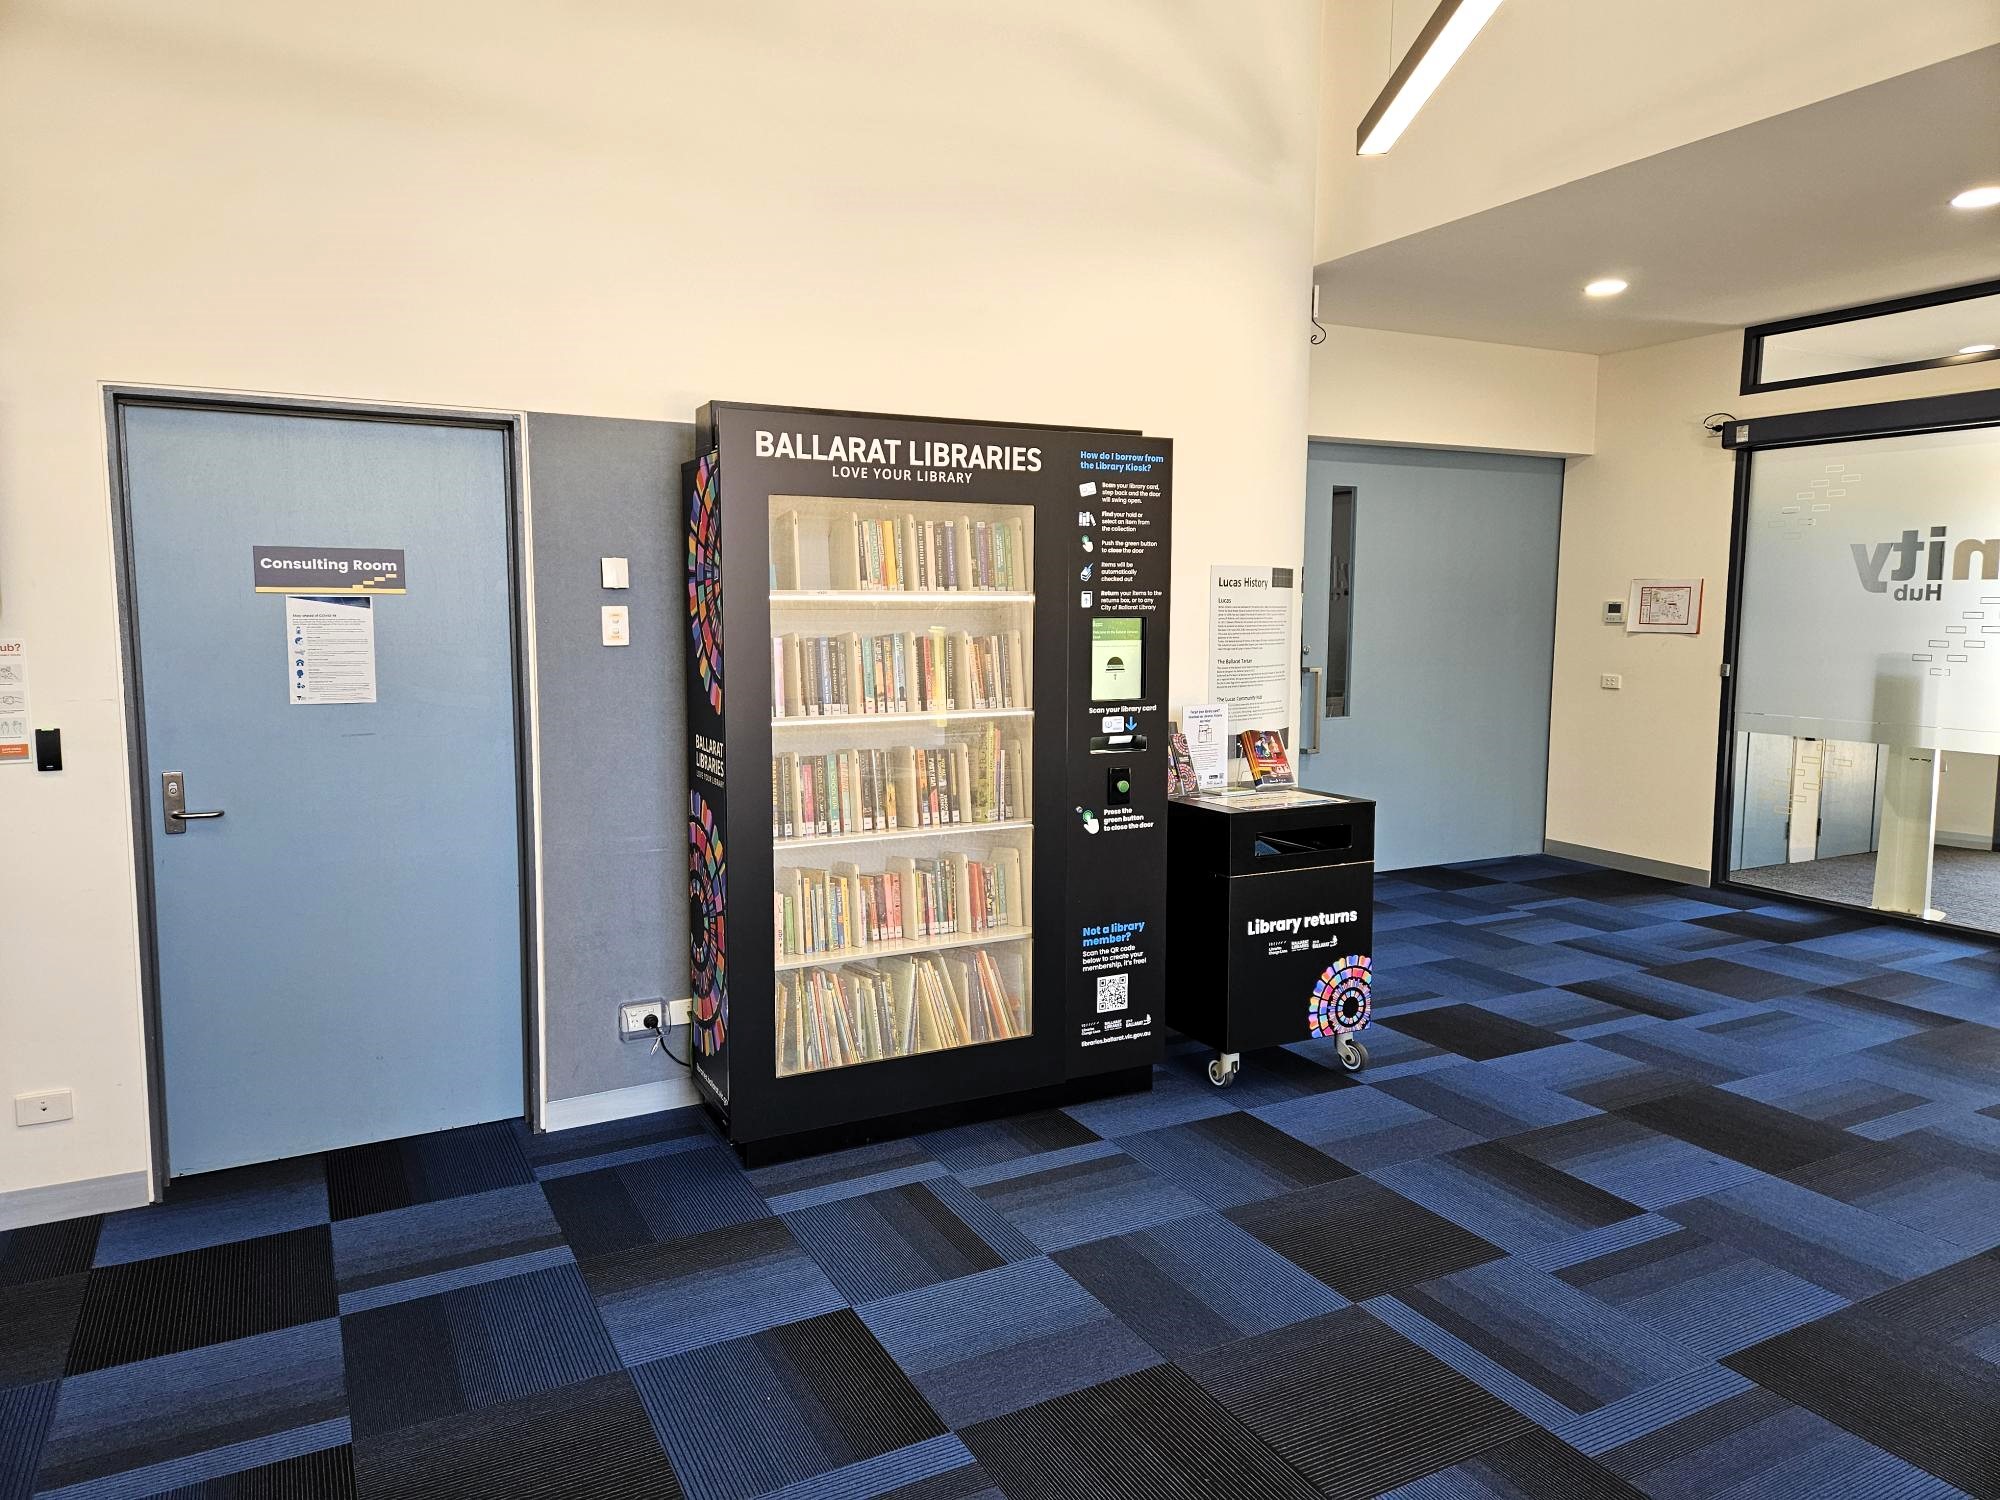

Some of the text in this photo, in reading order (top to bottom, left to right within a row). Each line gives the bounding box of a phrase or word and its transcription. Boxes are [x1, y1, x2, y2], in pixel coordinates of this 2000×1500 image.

[755, 430, 1042, 472] BALLARAT LIBRARIES
[1080, 451, 1098, 459] How
[1115, 453, 1143, 462] borrow
[1145, 454, 1163, 463] from
[1096, 462, 1124, 473] Library
[1126, 463, 1151, 472] Kiosk?
[832, 466, 972, 484] LOVE YOUR LIBRARY
[260, 558, 397, 573] Consulting Room
[1219, 577, 1268, 590] Lucas History
[1089, 706, 1103, 714] Scan
[1104, 706, 1119, 715] your
[1121, 705, 1141, 713] library
[696, 734, 723, 758] BALLARAT
[696, 751, 724, 777] LIBRARIES
[1104, 814, 1144, 824] green button
[1083, 926, 1101, 936] Not
[1111, 921, 1145, 933] library
[1248, 910, 1358, 936] Library returns
[1083, 932, 1131, 946] member?
[1083, 956, 1101, 965] below
[1130, 952, 1144, 960] your
[1083, 962, 1122, 972] membership,
[1081, 1031, 1151, 1047] libraries.ballarat.vic.gov.au
